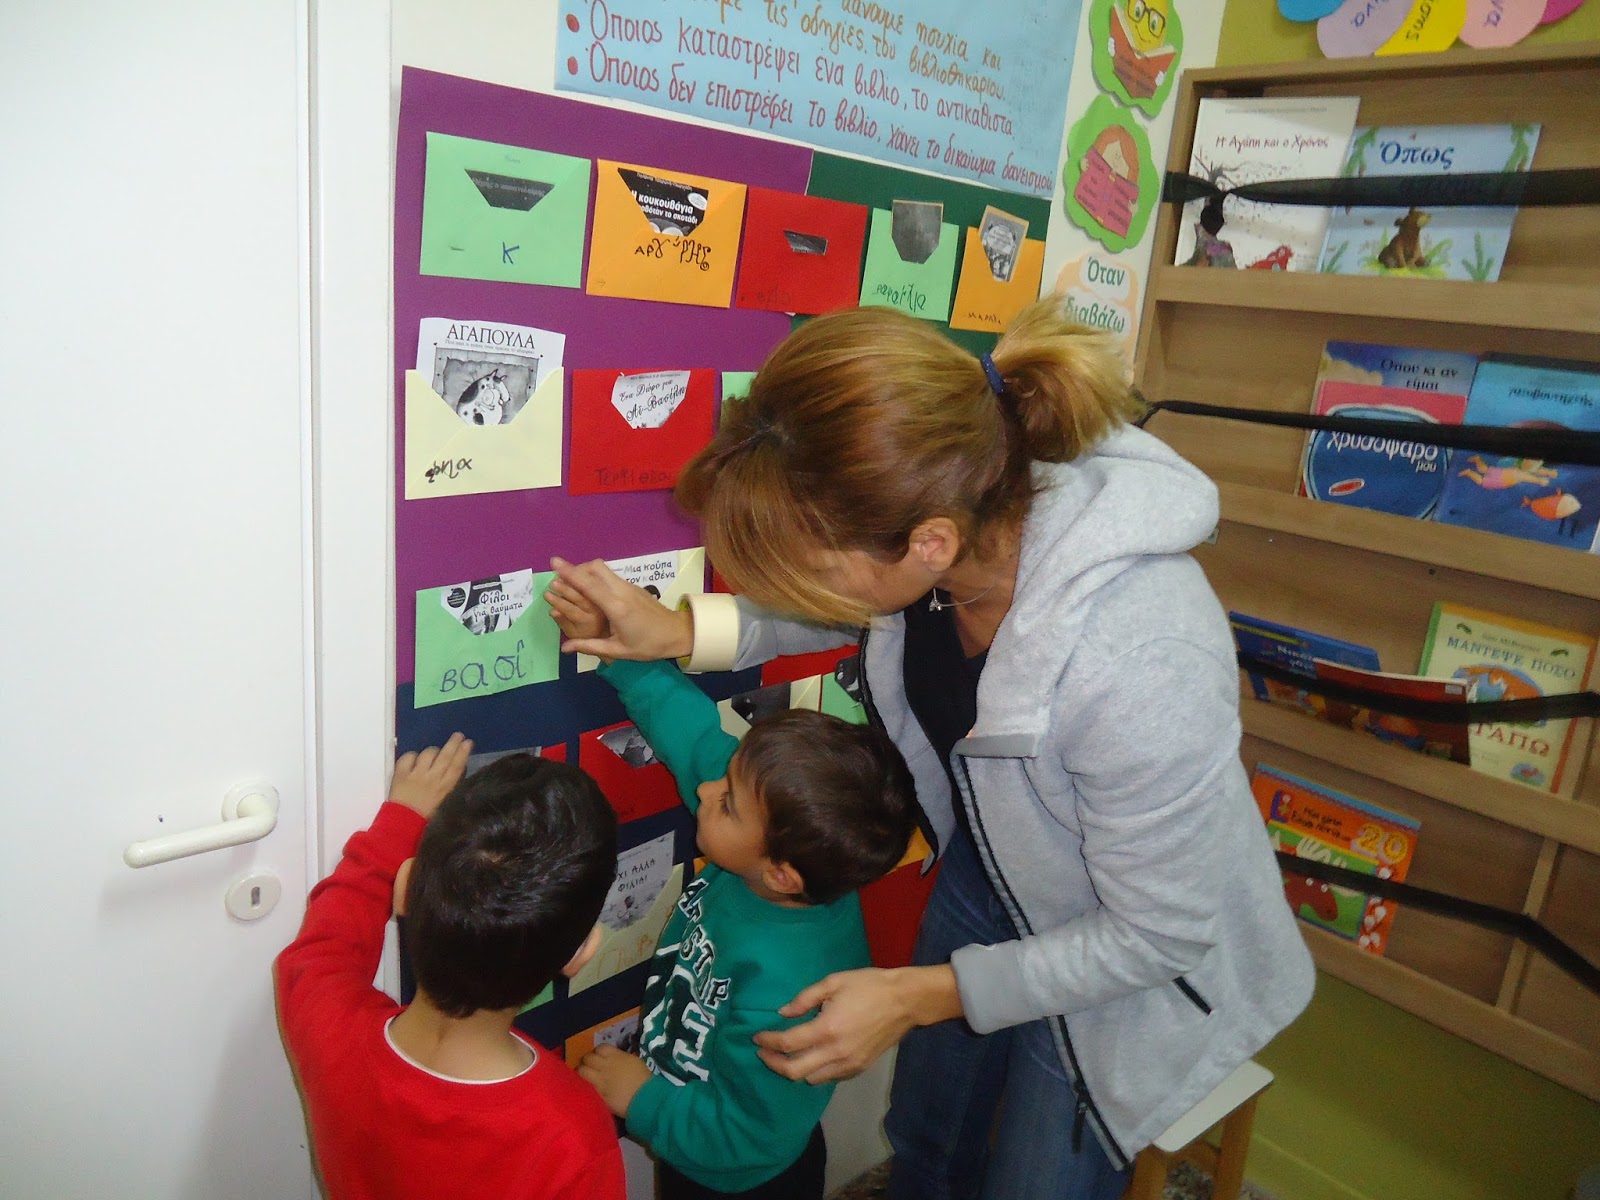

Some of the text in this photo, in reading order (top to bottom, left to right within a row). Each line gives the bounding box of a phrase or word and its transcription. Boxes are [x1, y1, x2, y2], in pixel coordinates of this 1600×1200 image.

[872, 33, 897, 60] του
[916, 21, 969, 62] ησυχία
[982, 47, 1001, 71] και
[586, 41, 660, 92] Όποιος
[669, 63, 696, 104] δεν
[808, 100, 826, 128] το
[887, 123, 920, 158] χάνει
[927, 139, 940, 159] το
[944, 133, 996, 181] δικαίωμα
[911, 88, 928, 111] το
[1264, 137, 1279, 148] και
[1282, 139, 1290, 148] ο
[1380, 141, 1455, 170] Όπως
[639, 192, 694, 214] κουκουβάγια
[665, 210, 672, 219] το
[673, 213, 698, 225] σκοτάδι
[1087, 257, 1126, 287] Όταν
[1063, 299, 1126, 334] διαβάζω
[447, 323, 536, 350] ΑΓΑΠΟΥΛΑ
[480, 590, 509, 604] Φίλοι
[490, 602, 523, 617] θαύματα
[1447, 636, 1524, 667] ΜΑΝΤΕΨΕ
[1531, 658, 1576, 680] ΠΟΣΟ
[1354, 822, 1410, 865] 20
[617, 870, 627, 882] ΧΙ
